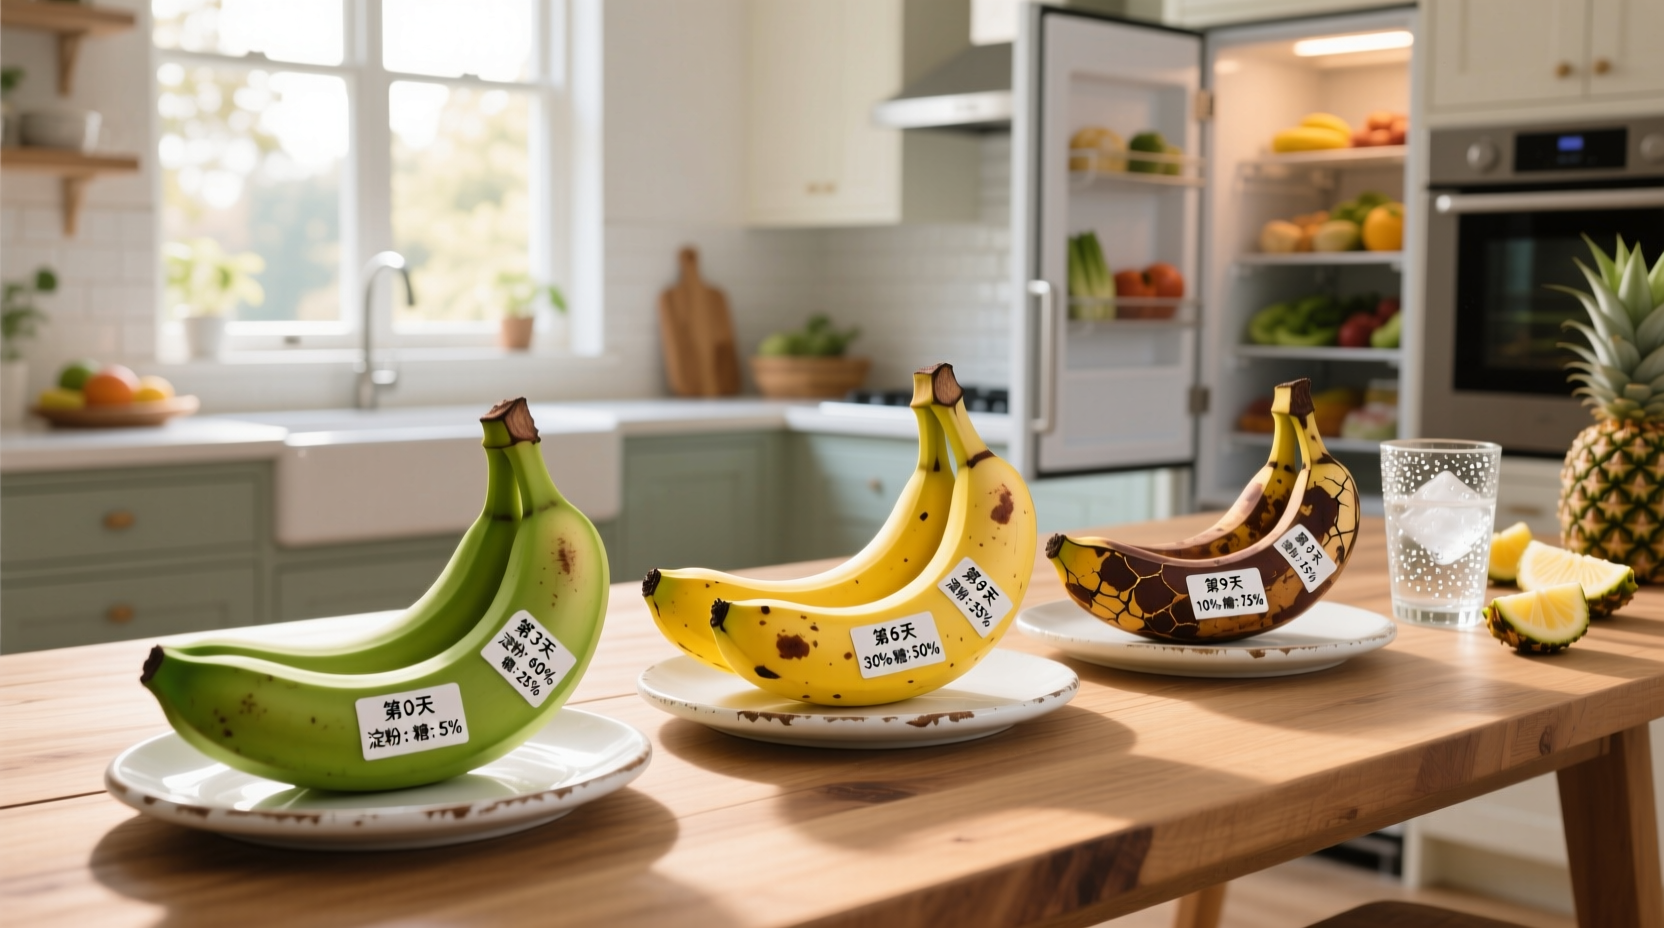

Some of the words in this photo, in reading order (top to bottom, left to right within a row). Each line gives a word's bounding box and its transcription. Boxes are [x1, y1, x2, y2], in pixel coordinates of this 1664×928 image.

[515, 618, 556, 660] 第3天
[873, 622, 917, 646] 第6天
[383, 695, 435, 721] 第0天
